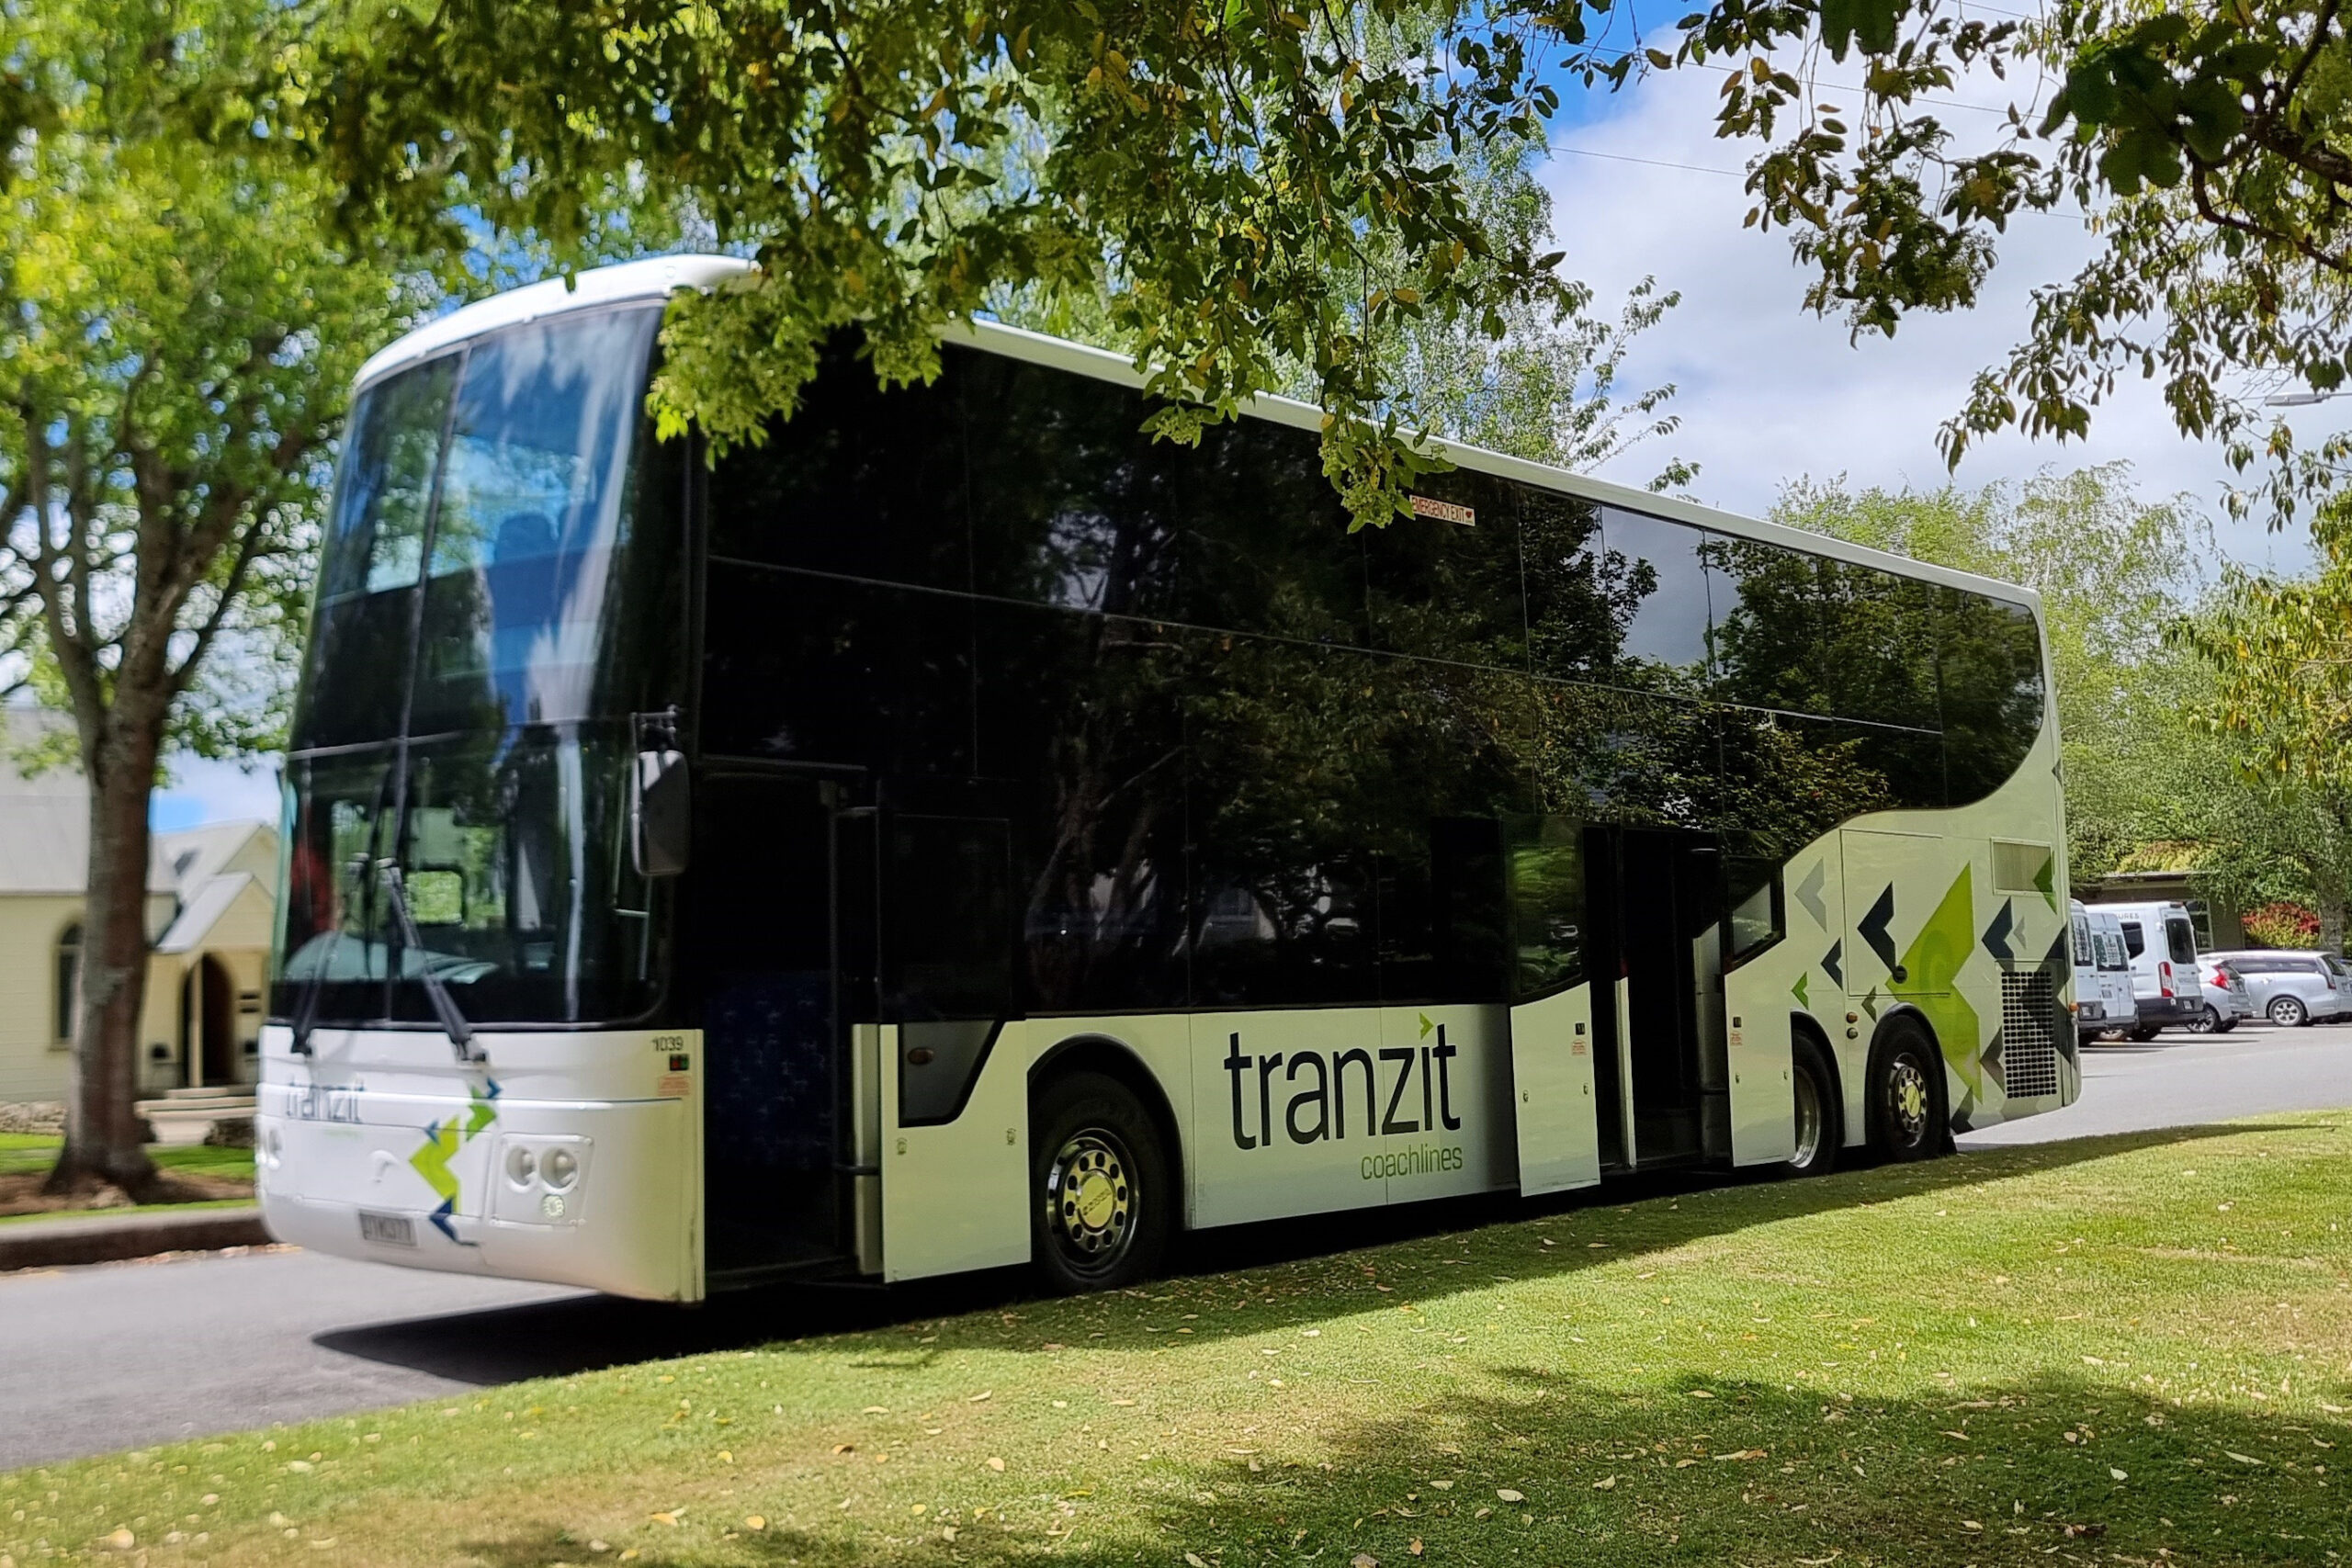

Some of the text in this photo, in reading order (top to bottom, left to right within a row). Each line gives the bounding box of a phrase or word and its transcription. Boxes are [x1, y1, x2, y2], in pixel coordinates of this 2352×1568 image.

[1411, 497, 1464, 523] EMERGENCY EXIT
[651, 1036, 684, 1052] 1039
[1224, 1012, 1462, 1150] tranzit
[1361, 1144, 1463, 1180] coachlines
